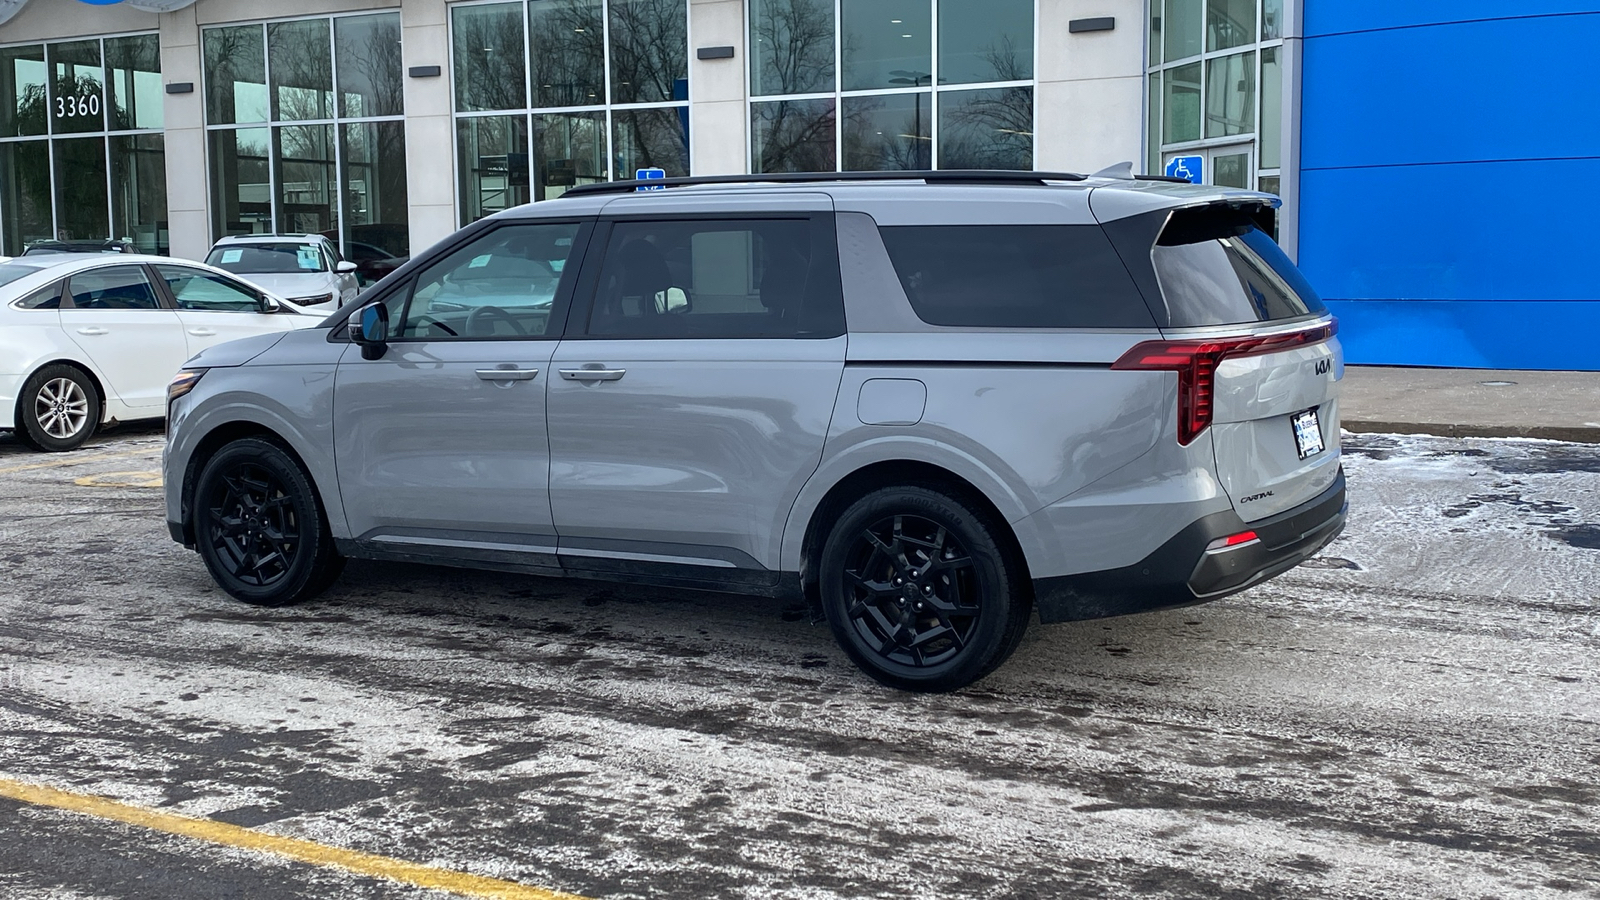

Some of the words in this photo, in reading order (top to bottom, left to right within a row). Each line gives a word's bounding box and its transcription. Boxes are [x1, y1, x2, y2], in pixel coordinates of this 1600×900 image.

[56, 93, 99, 118] 3360
[1314, 357, 1331, 376] KIA
[1240, 490, 1275, 504] CARNIVAL
[900, 495, 963, 527] GOODYEAR
